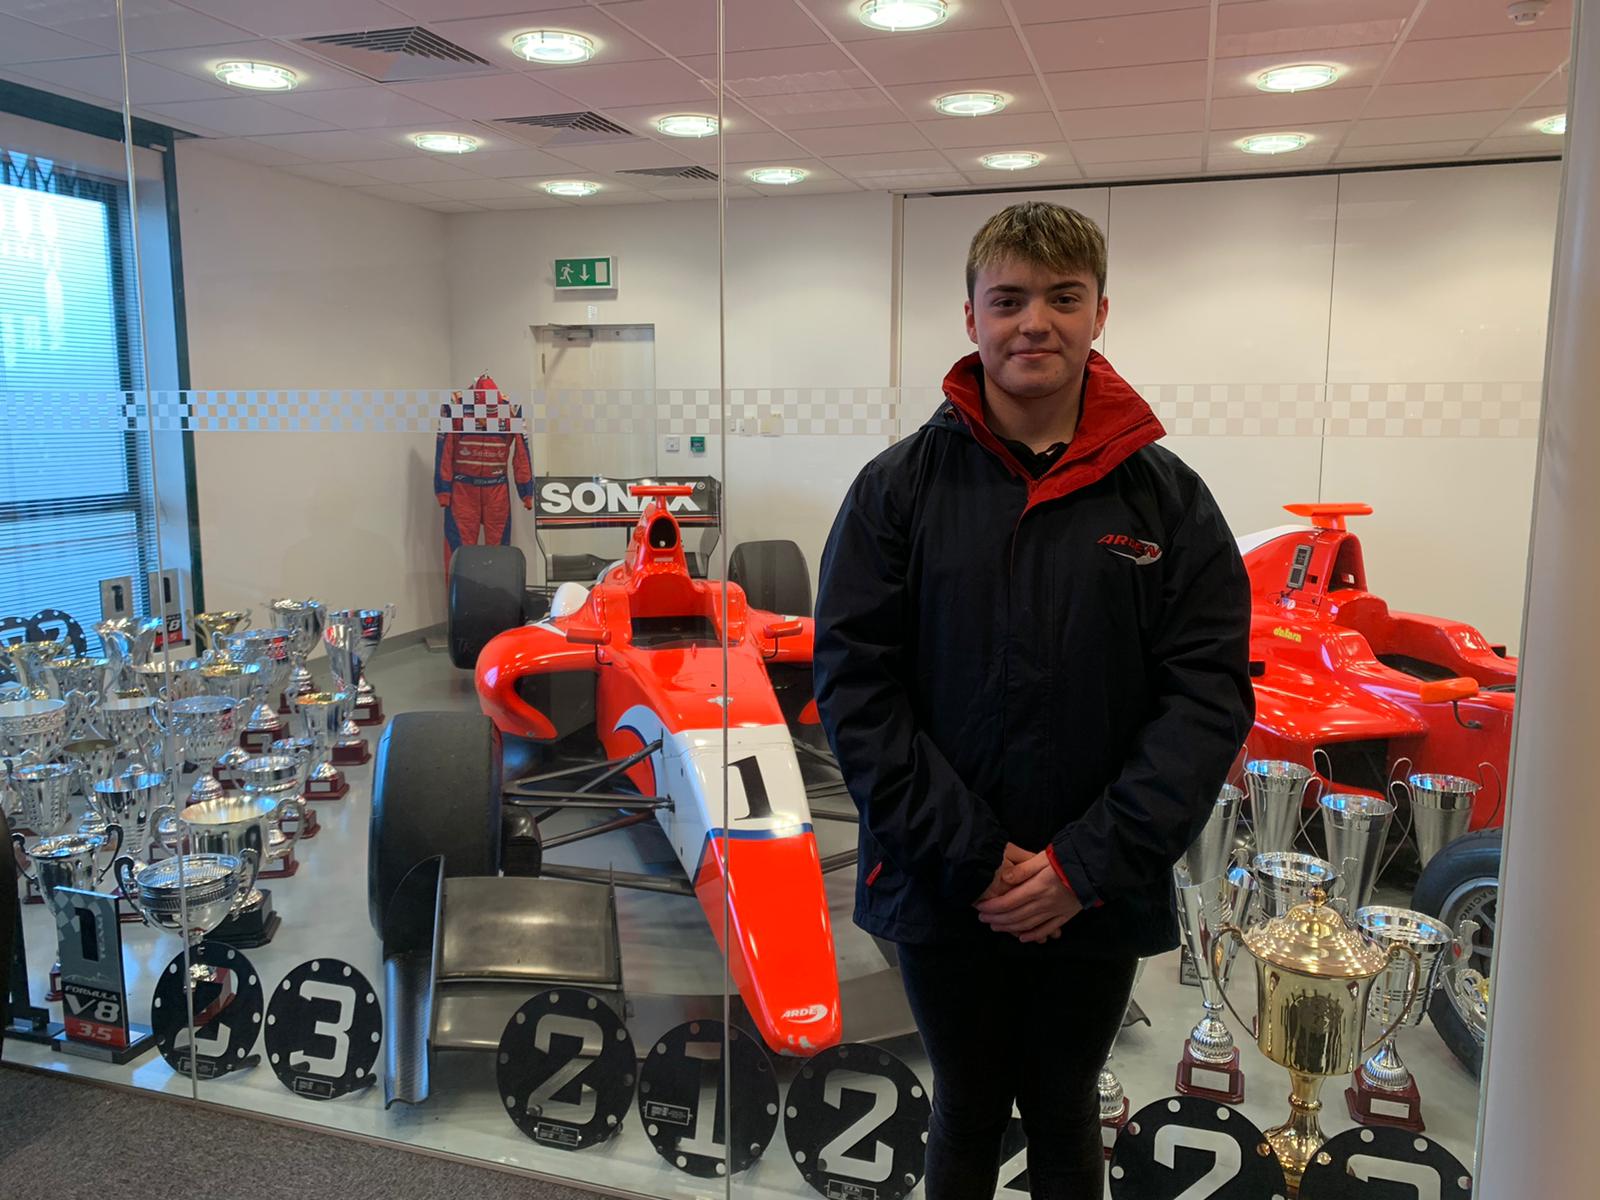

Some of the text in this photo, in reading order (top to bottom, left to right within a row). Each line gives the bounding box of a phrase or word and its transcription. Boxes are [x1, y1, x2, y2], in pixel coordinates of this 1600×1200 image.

[722, 755, 772, 820] 1
[75, 907, 99, 962] 1
[64, 993, 121, 1024] V8
[65, 984, 118, 1001] FORMULA
[77, 1022, 113, 1041] 3.5
[289, 979, 356, 1078] 3
[527, 1013, 604, 1125] 2
[818, 1069, 898, 1182] 2
